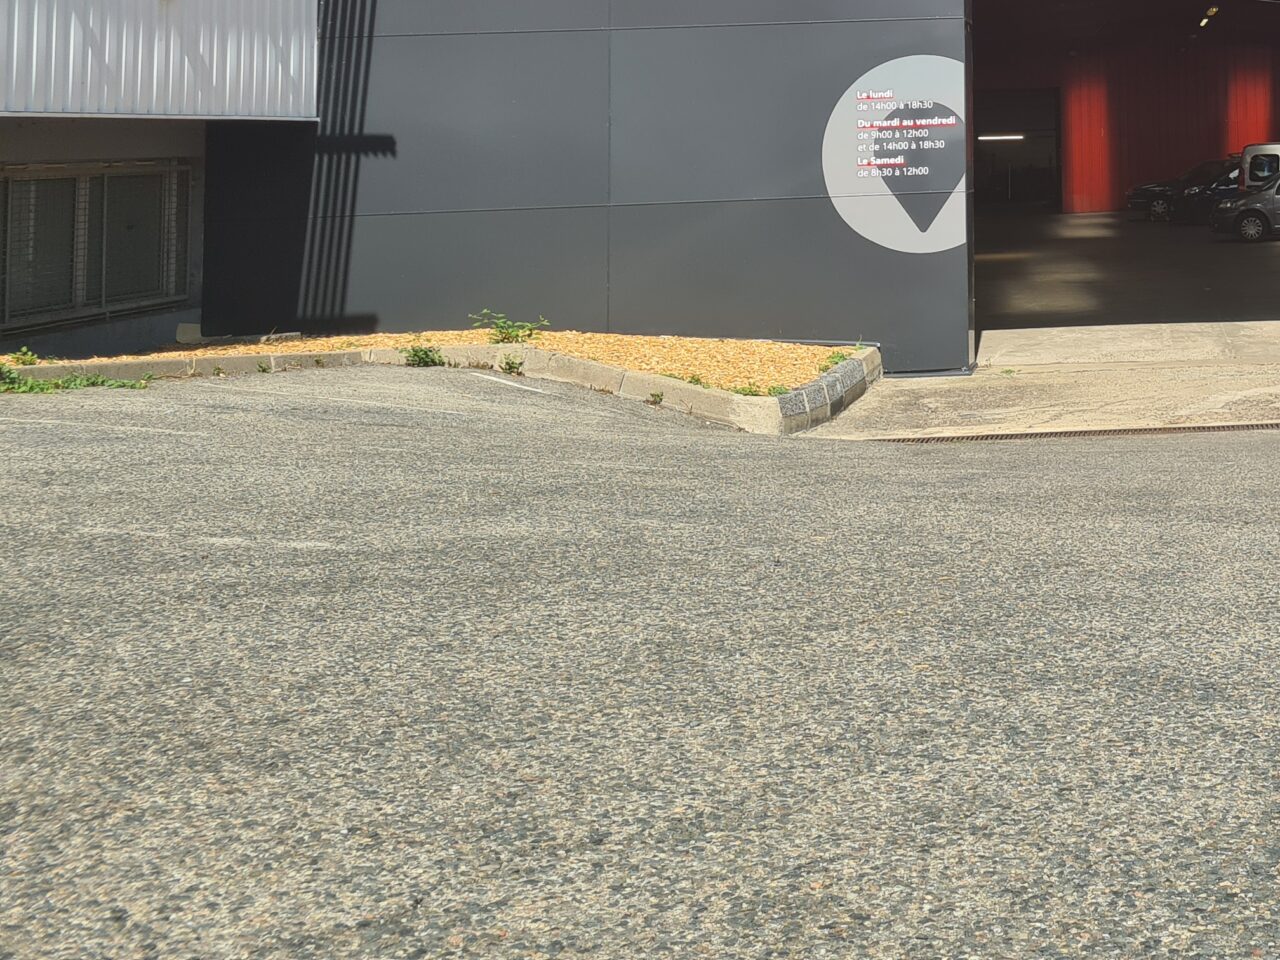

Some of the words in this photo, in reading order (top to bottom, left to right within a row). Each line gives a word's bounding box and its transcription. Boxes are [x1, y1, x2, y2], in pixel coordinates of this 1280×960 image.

[857, 91, 868, 99] Le
[869, 90, 893, 99] lundi
[857, 103, 868, 111] de
[871, 102, 897, 110] 14h00
[907, 101, 934, 109] 18h30
[857, 120, 871, 128] Du
[873, 118, 900, 127] mardi
[915, 116, 956, 126] vendredi
[857, 131, 869, 140] de
[871, 131, 893, 139] 9h00
[894, 130, 900, 138] à
[902, 129, 929, 138] 12h00
[857, 144, 867, 152] et
[868, 143, 880, 151] de
[883, 142, 909, 151] 14h00
[919, 141, 945, 149] 18h30
[857, 157, 868, 166] Le
[870, 156, 904, 165] Samedi
[871, 169, 893, 177] 8h30
[894, 168, 900, 176] à
[902, 167, 929, 176] 12h00
